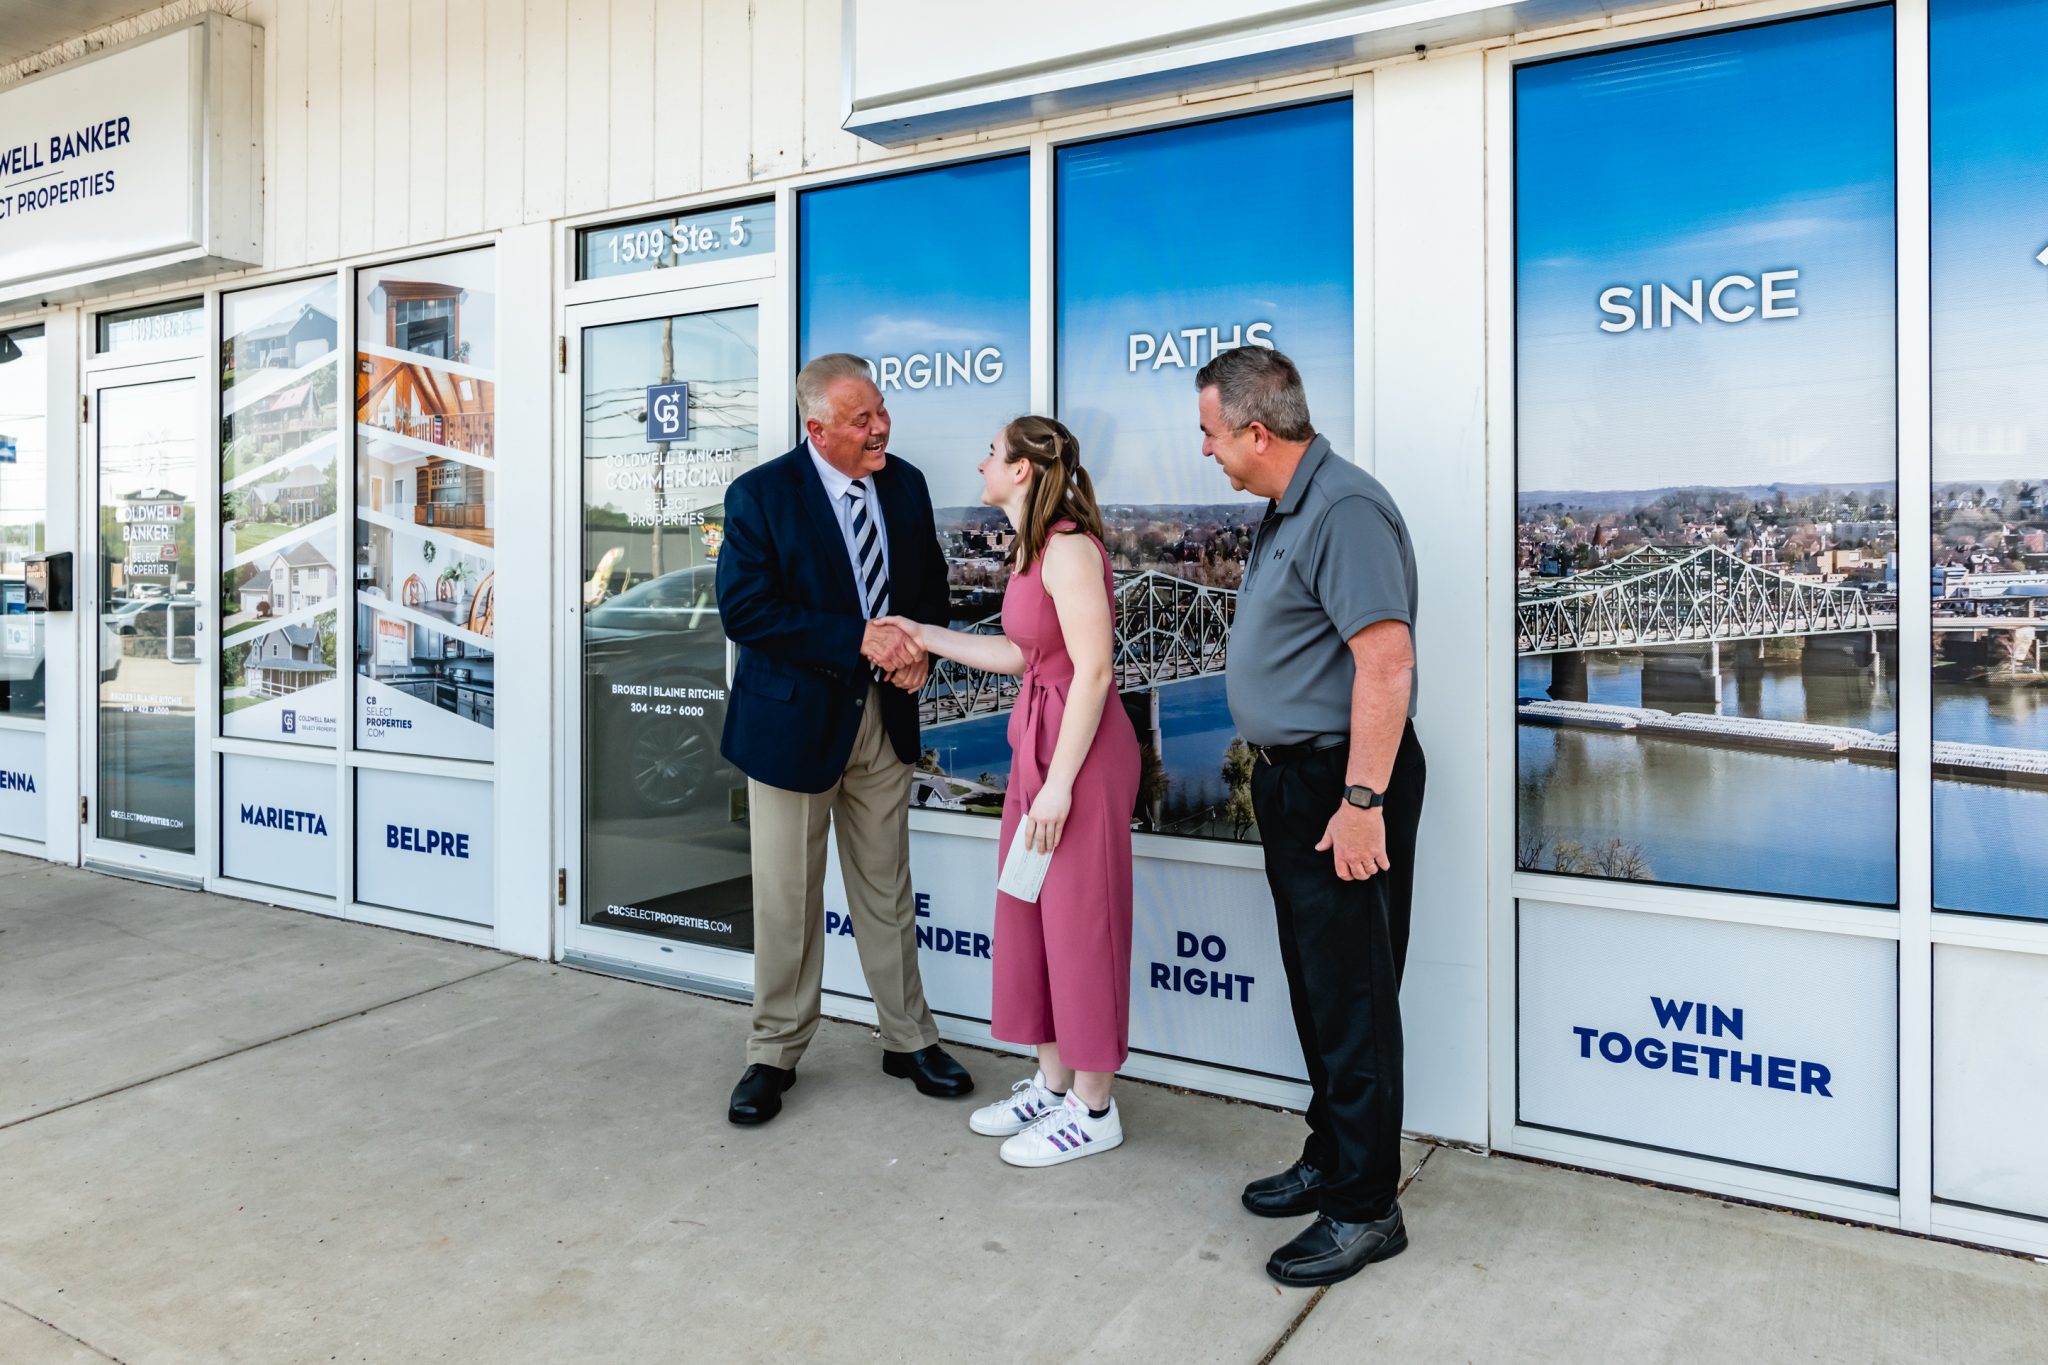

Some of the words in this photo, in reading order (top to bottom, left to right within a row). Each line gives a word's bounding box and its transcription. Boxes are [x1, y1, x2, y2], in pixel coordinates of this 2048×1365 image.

[50, 116, 130, 164] BANKER
[18, 170, 115, 215] PROPERTIES
[608, 228, 664, 264] 1509
[671, 223, 720, 255] Ste.
[729, 215, 745, 247] 5
[1599, 269, 1799, 333] SINCE
[1129, 322, 1275, 372] PATHS
[605, 451, 675, 468] COLDWELL
[678, 447, 733, 464] BANKER
[606, 467, 732, 491] COMMERCIAL
[645, 497, 690, 511] SELECT
[630, 512, 705, 527] PROPERTIES
[122, 524, 169, 541] BANKER
[123, 564, 169, 575] PROPERTIES
[367, 696, 377, 705] CB
[611, 684, 647, 696] BROKER
[653, 687, 686, 698] BLAINE
[688, 689, 725, 700] RITCHIE
[366, 707, 392, 717] SELECT
[630, 703, 648, 713] 304
[654, 704, 672, 715] 422
[678, 706, 704, 717] 6000
[366, 718, 413, 729] PROPERTIES
[366, 728, 385, 738] .COM
[0, 770, 36, 794] ENNA
[241, 803, 328, 836] MARIETTA
[386, 824, 470, 859] BELPRE
[915, 892, 931, 918] E
[607, 904, 732, 934] CBCSELECTPROPERTIES.COM
[1177, 930, 1227, 962] DO
[1150, 961, 1255, 1003] RIGHT
[1650, 995, 1744, 1041] WIN
[1572, 1025, 1835, 1098] TOGETHER
